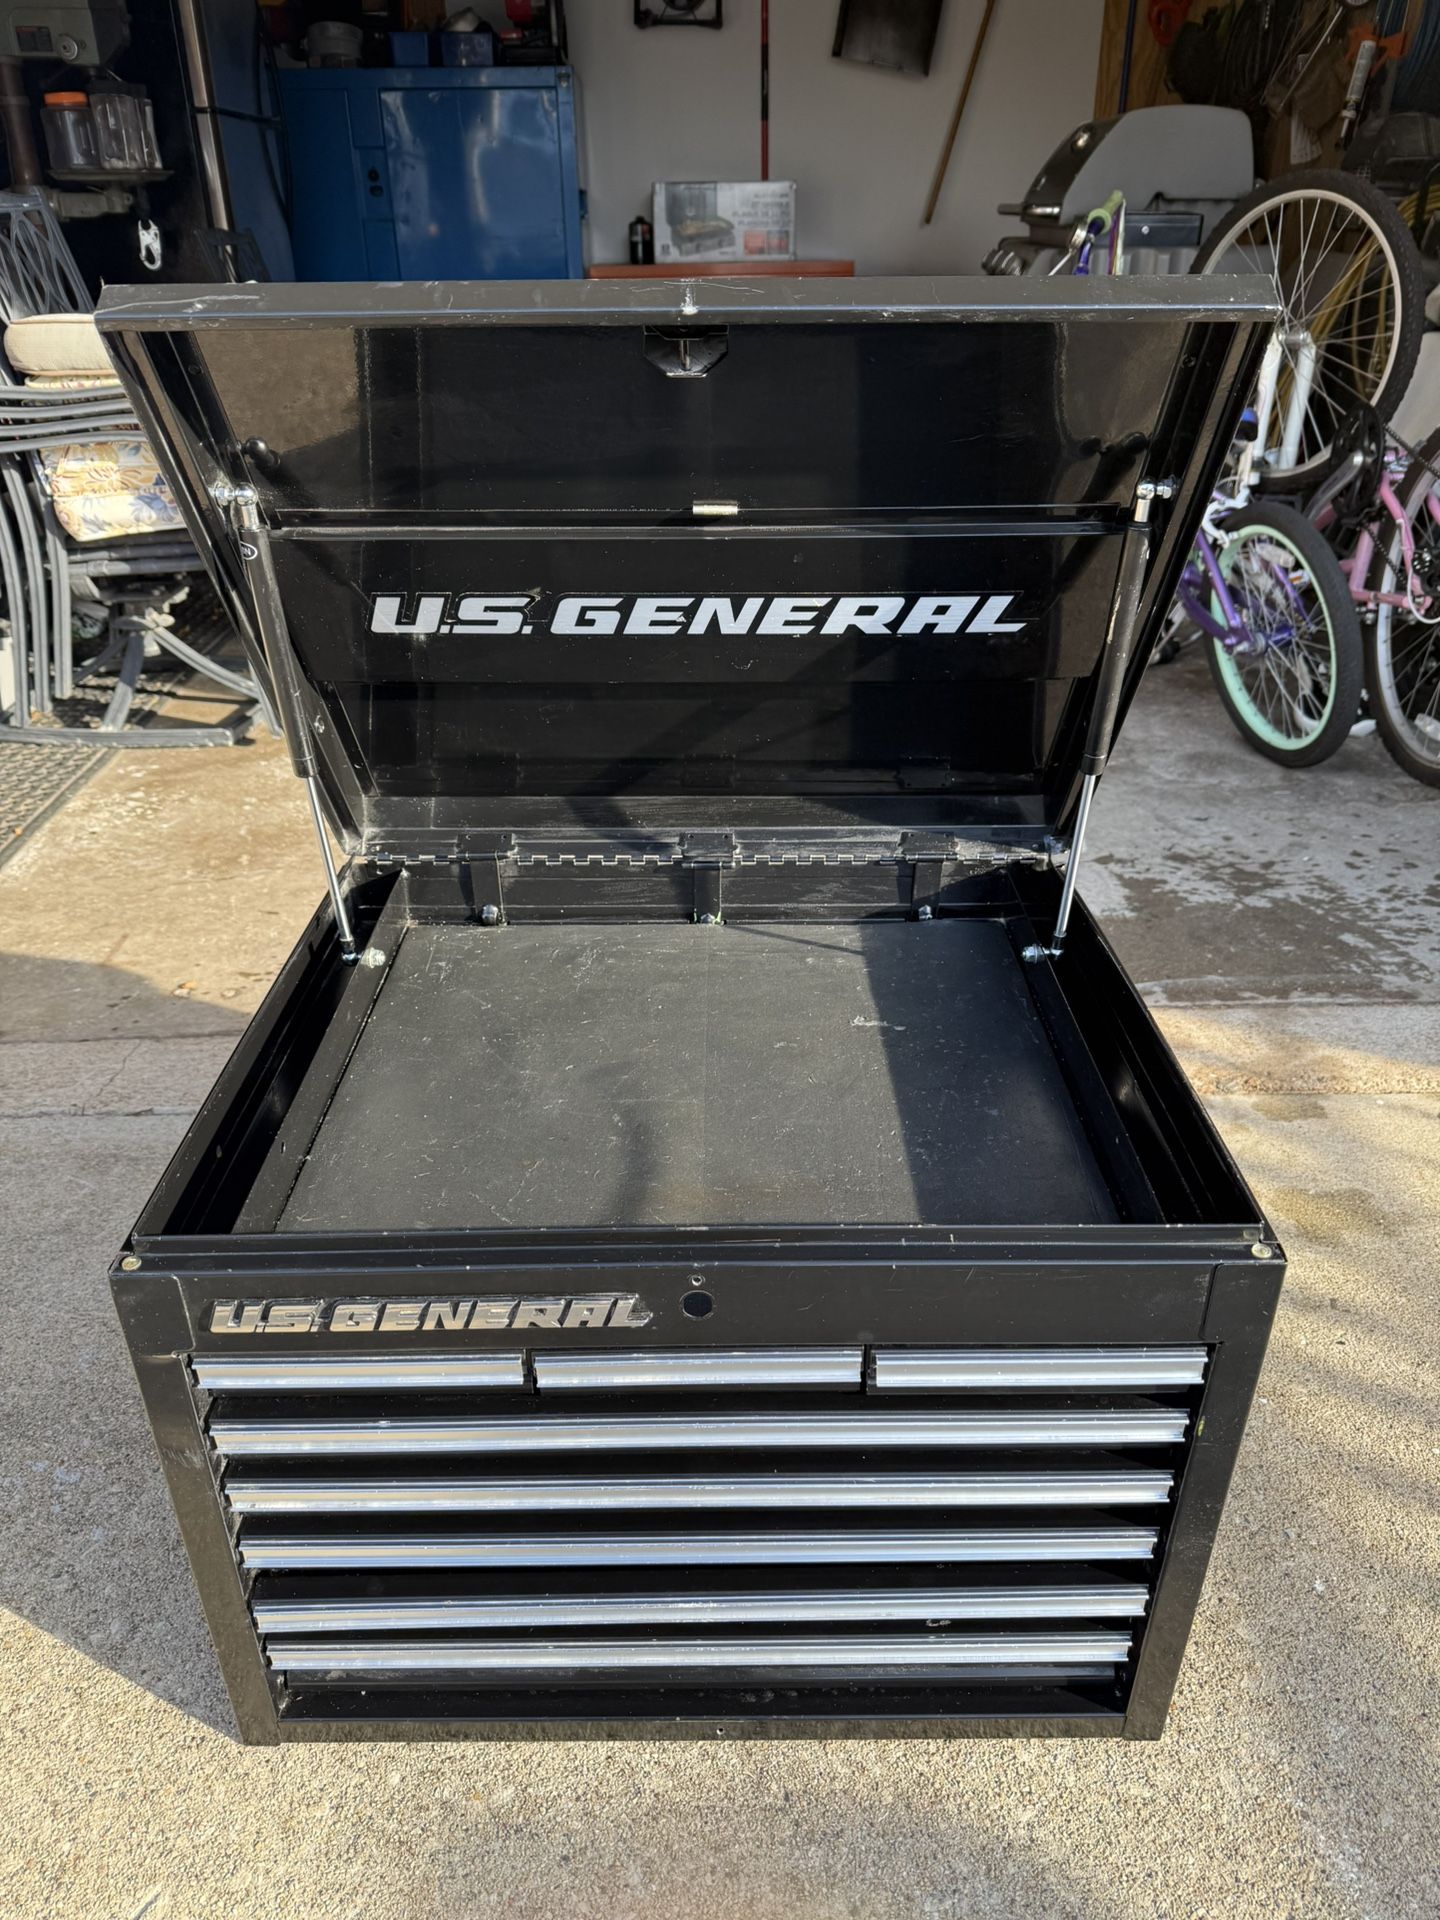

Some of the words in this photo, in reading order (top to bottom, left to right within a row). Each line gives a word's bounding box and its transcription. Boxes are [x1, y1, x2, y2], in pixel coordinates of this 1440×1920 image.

[370, 596, 532, 635] U.S.
[550, 595, 1027, 635] GENERAL
[210, 1299, 324, 1333] U.S.
[330, 1295, 653, 1332] GENERAL
